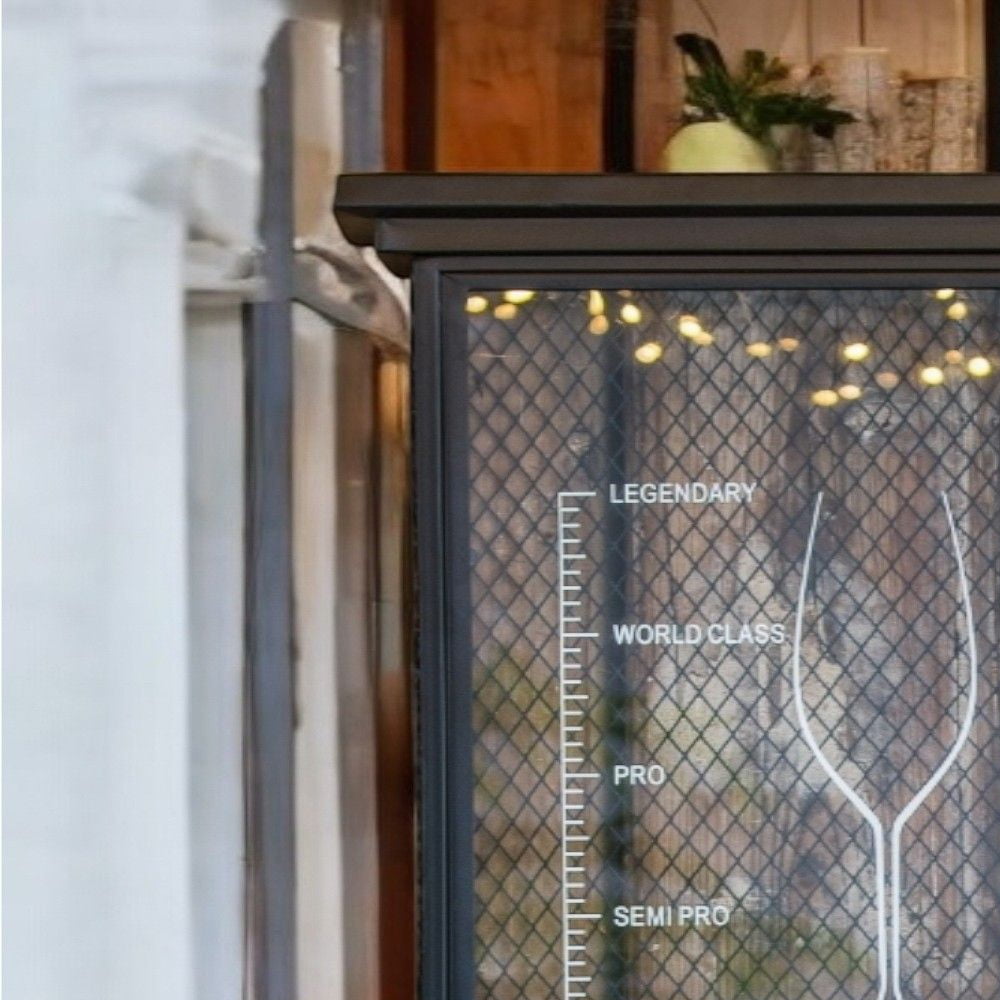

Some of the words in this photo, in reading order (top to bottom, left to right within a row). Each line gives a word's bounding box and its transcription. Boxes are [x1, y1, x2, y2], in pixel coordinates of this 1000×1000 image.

[609, 482, 757, 504] LEGENDARY
[612, 623, 701, 645] WORLD
[707, 623, 786, 645] CLASS
[614, 764, 665, 786] PRO
[613, 905, 672, 927] SEMI
[677, 905, 730, 927] PRO
